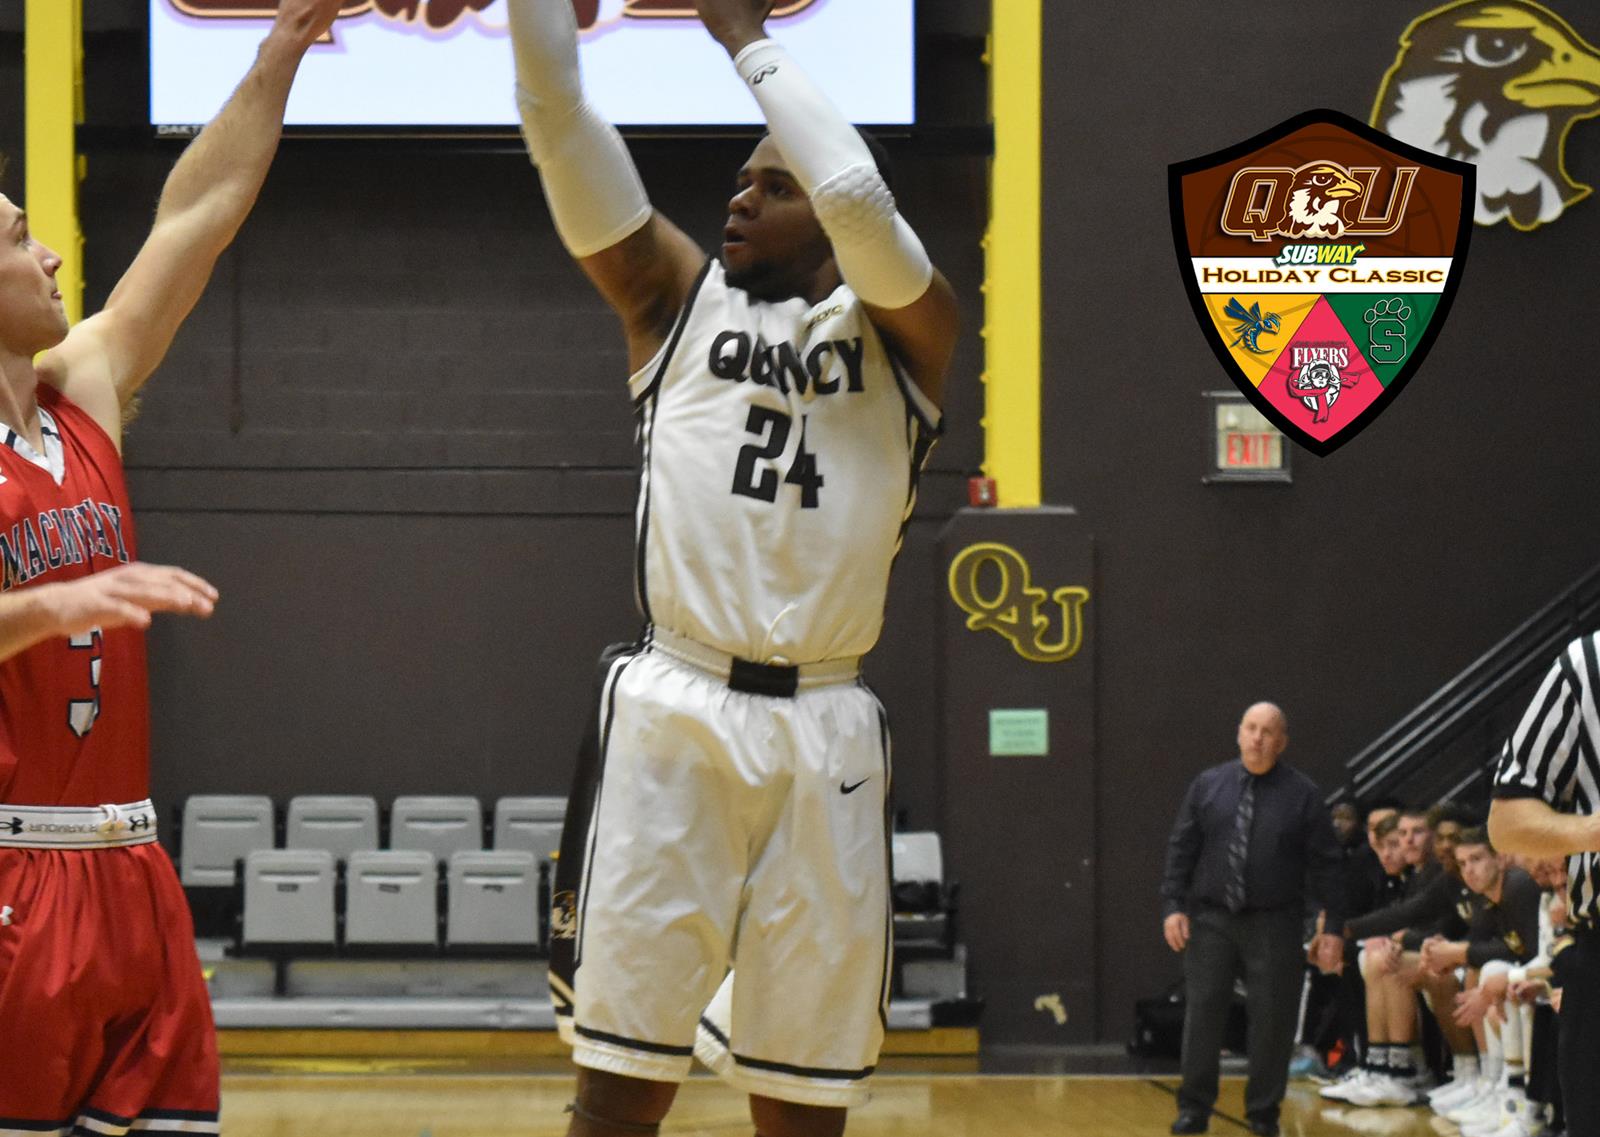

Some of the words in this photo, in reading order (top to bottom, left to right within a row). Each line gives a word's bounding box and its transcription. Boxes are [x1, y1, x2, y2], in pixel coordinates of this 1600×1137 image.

[731, 404, 824, 508] 24
[1227, 432, 1272, 465] EXIT
[948, 542, 1089, 662] QU
